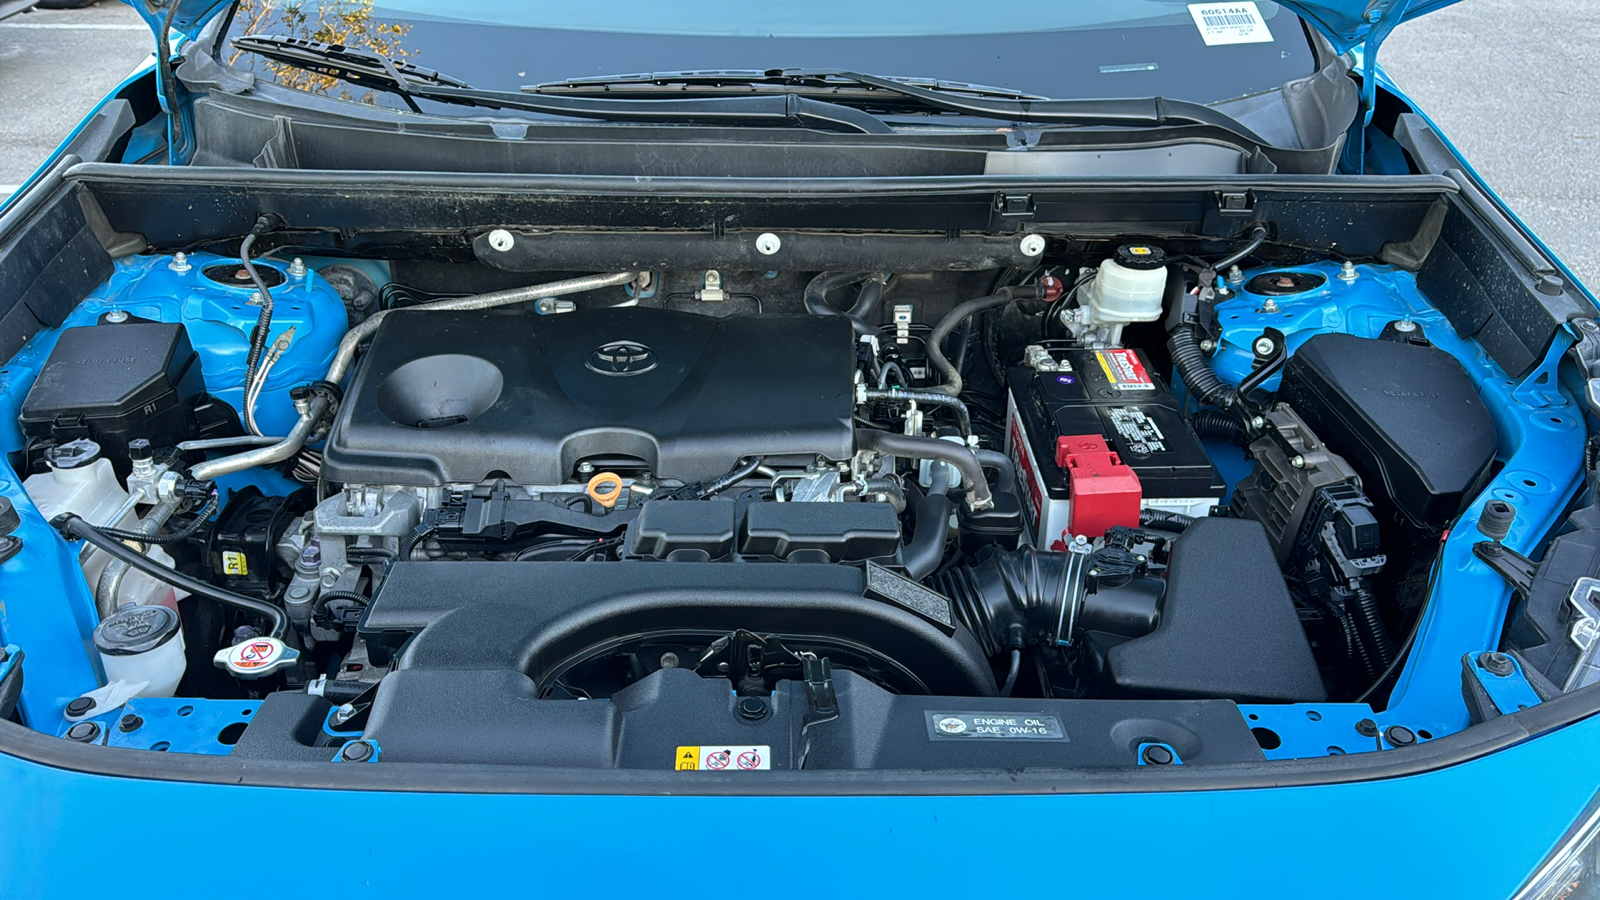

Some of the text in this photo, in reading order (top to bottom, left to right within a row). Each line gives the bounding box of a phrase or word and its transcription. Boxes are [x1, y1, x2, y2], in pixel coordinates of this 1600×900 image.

[143, 402, 157, 415] R1
[227, 556, 239, 570] R1
[973, 718, 1045, 727] ENGINE OIL
[976, 726, 1047, 735] SAE 0W-16
